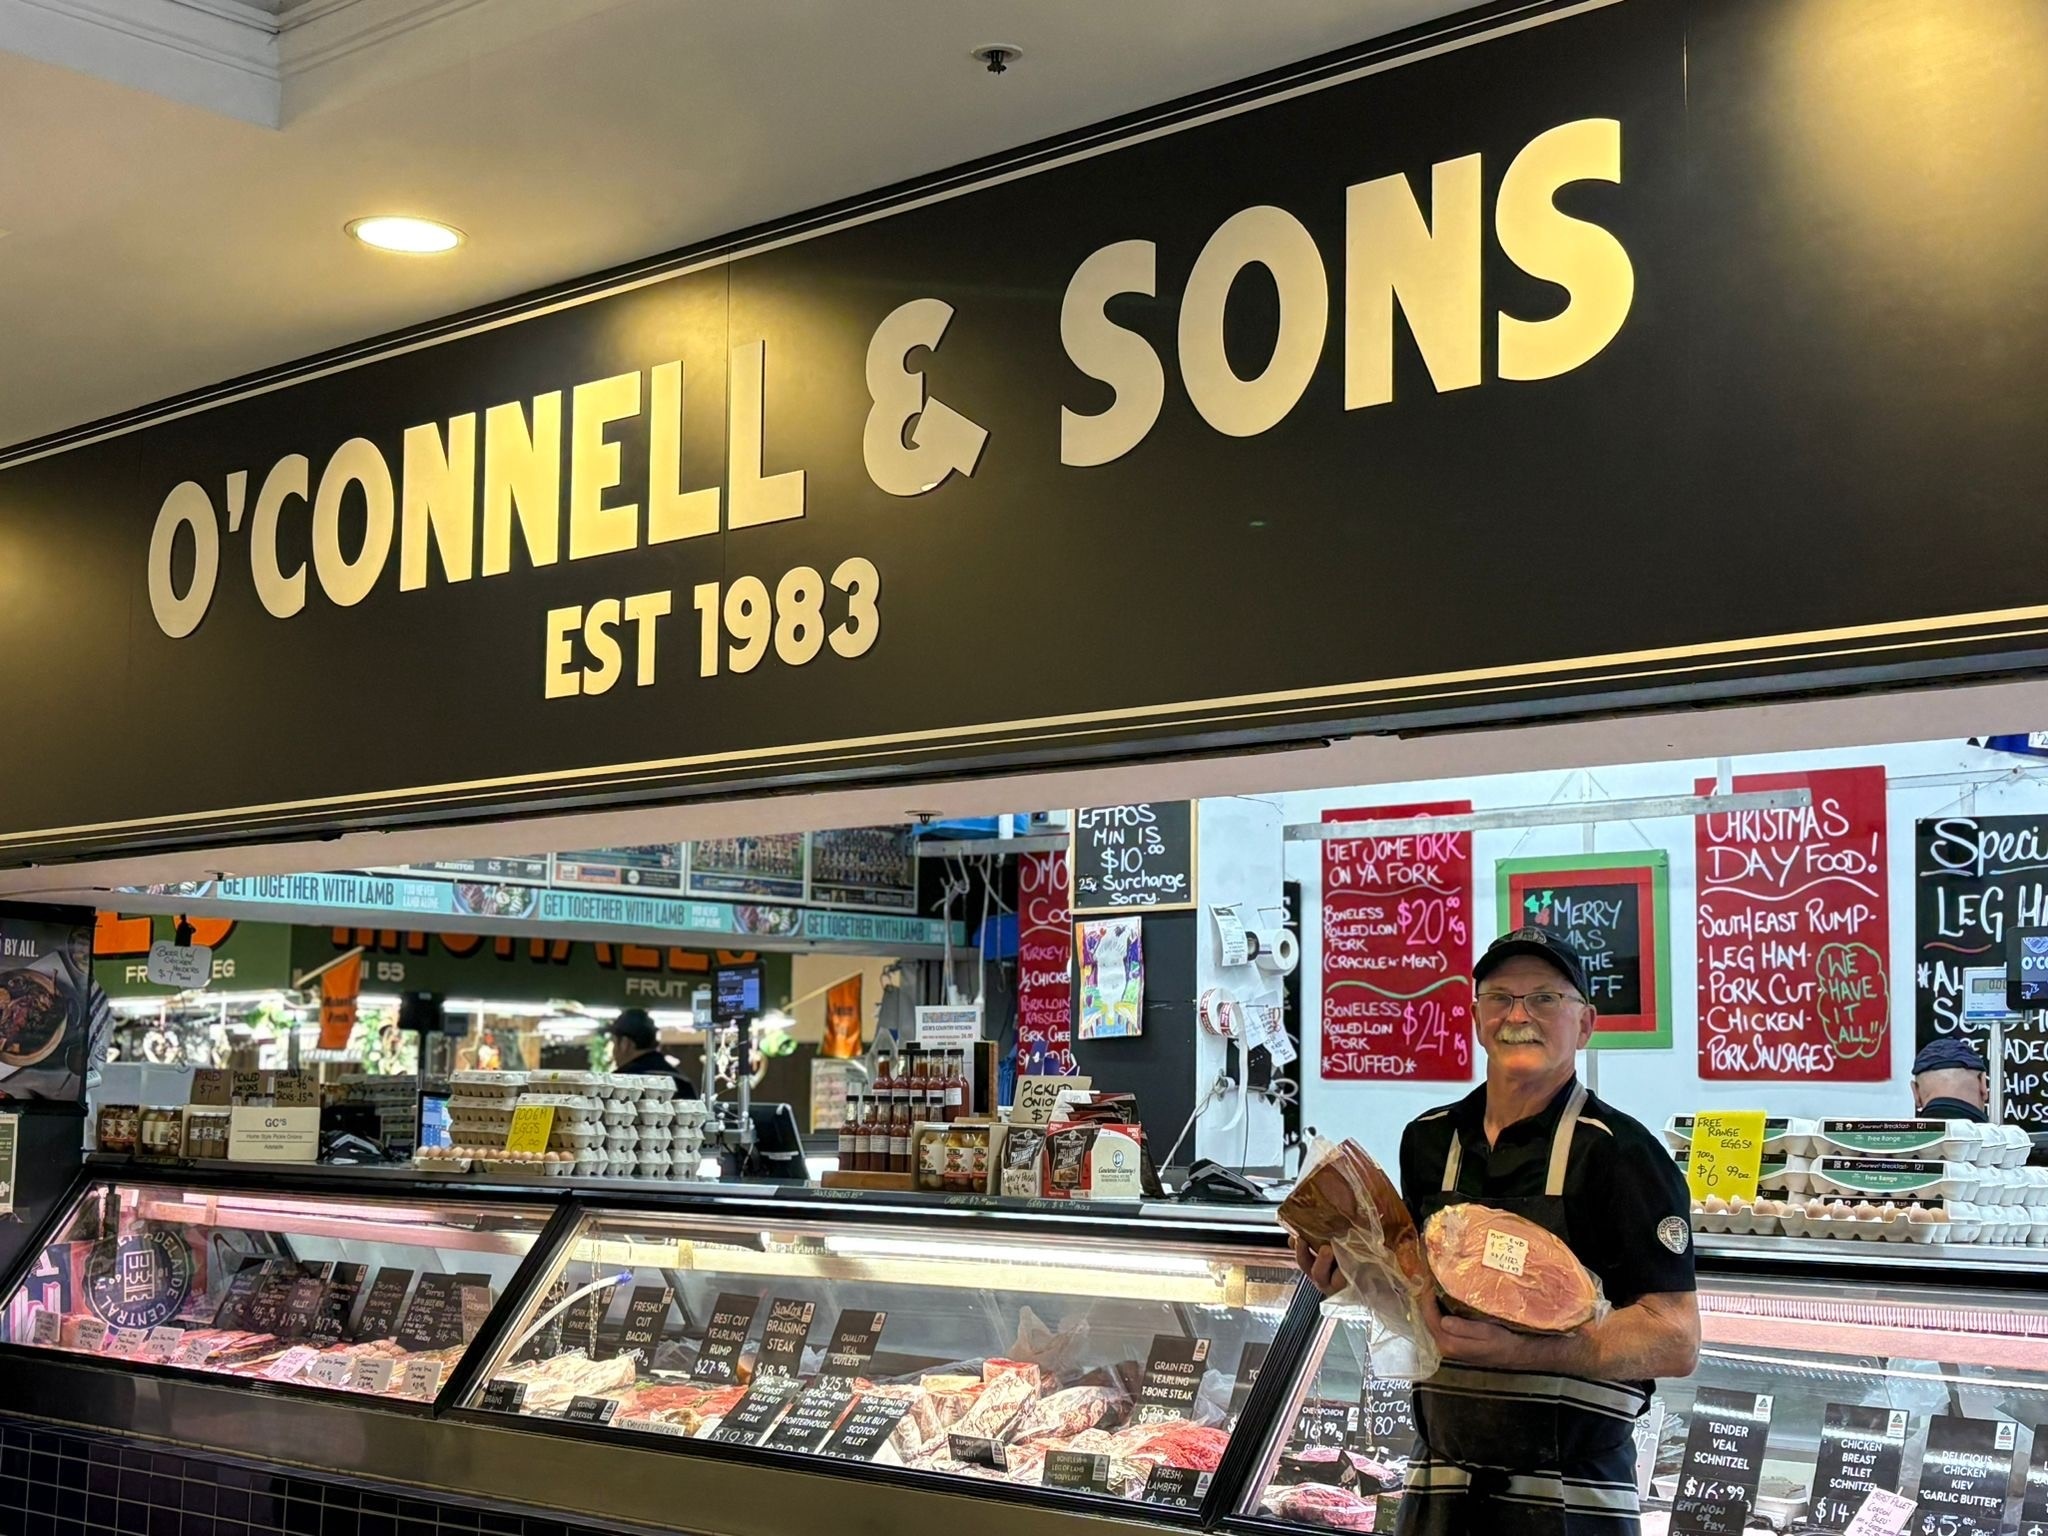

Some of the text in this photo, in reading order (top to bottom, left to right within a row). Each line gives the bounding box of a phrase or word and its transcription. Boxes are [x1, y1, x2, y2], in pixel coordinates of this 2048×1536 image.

[148, 117, 1634, 638] O'CONNELL & SONS
[545, 557, 881, 700] EST 1983
[1078, 804, 1156, 829] EFTPOS
[1093, 826, 1162, 847] MIN IS
[1930, 818, 2048, 877] Speci
[1705, 832, 1878, 888] DAY FOOD!
[1020, 853, 1068, 895] SMO
[1329, 863, 1443, 887] ON YA FORK
[322, 878, 358, 904] WITH
[359, 881, 394, 906] LAMB
[543, 895, 685, 925] GET TOGETHER WITH LAMB
[1324, 905, 1384, 925] BONELESS
[1554, 896, 1623, 930] MERRY
[1937, 886, 2004, 943] LEG
[807, 913, 925, 941] GET TOGETHER WITH LAMB
[1324, 923, 1369, 938] ROLLED
[1369, 923, 1397, 935] LOIN
[4, 938, 39, 958] BY ALL.
[1020, 943, 1064, 962] TURKEY
[1329, 938, 1368, 952] PORK
[1401, 951, 1448, 973] MEAT)
[1579, 951, 1615, 971] THE
[1709, 940, 1807, 973] LEG HAM
[1828, 951, 1858, 978] WE
[1031, 971, 1071, 987] CHICKE
[625, 977, 688, 998] FRUIT
[1709, 971, 1816, 1005] PORK CUT
[1828, 976, 1877, 1003] HAVE
[1020, 995, 1044, 1013] PORK
[1324, 998, 1401, 1017] BONELESS
[1707, 1006, 1804, 1033] CHICKEN
[1833, 1003, 1861, 1025] IT
[1019, 1024, 1071, 1042] PORK CHEE
[1323, 1018, 1362, 1036] ROLLED
[1364, 1023, 1393, 1034] LOIN
[1329, 1036, 1370, 1050] PORK
[1707, 1034, 1834, 1073] PORK SAUSAGES
[513, 1123, 540, 1135] EGGS
[1697, 1117, 1722, 1127] FREE
[1707, 1127, 1739, 1137] RANGE
[101, 1296, 167, 1327] CENTRAL
[633, 1301, 664, 1312] FRESHLY
[636, 1317, 652, 1327] CUT
[714, 1314, 749, 1326] BEST CUT
[766, 1319, 807, 1336] BRAISING
[626, 1330, 652, 1343] BACON
[708, 1328, 744, 1342] YEARLING
[841, 1334, 868, 1343] QUALITY
[709, 1344, 732, 1356] RUMP
[767, 1338, 795, 1353] STEAK
[843, 1345, 857, 1354] VEAL
[832, 1357, 860, 1366] CUTLETS
[1154, 1361, 1194, 1373] GRAIN FED
[1152, 1374, 1189, 1386] YEARLING
[749, 1392, 783, 1404] BULK BUY
[1142, 1386, 1193, 1400] T-BONE STEAK
[737, 1413, 760, 1423] STEAK
[797, 1407, 830, 1418] BULK BUY
[782, 1417, 831, 1430] PORTERHOUSE
[853, 1415, 888, 1426] BULK BUY
[787, 1427, 810, 1437] STEAK
[847, 1425, 878, 1436] SCOTCH
[1709, 1422, 1749, 1437] TENDER
[842, 1436, 868, 1447] FILLET
[1712, 1438, 1738, 1452] VEAL
[1841, 1439, 1882, 1452] CHICKEN
[1694, 1452, 1750, 1470] SCHNITZEL
[1842, 1452, 1877, 1465] BREAST
[1942, 1451, 1993, 1464] DELICIOUS
[1842, 1466, 1872, 1479] FILLET
[1943, 1465, 1987, 1478] CHICKEN
[1951, 1479, 1974, 1490] KIEV
[1920, 1490, 2002, 1508] "GARLIC BUTTER"
[1676, 1501, 1726, 1515] EAT NOW
[1696, 1514, 1712, 1522] OR
